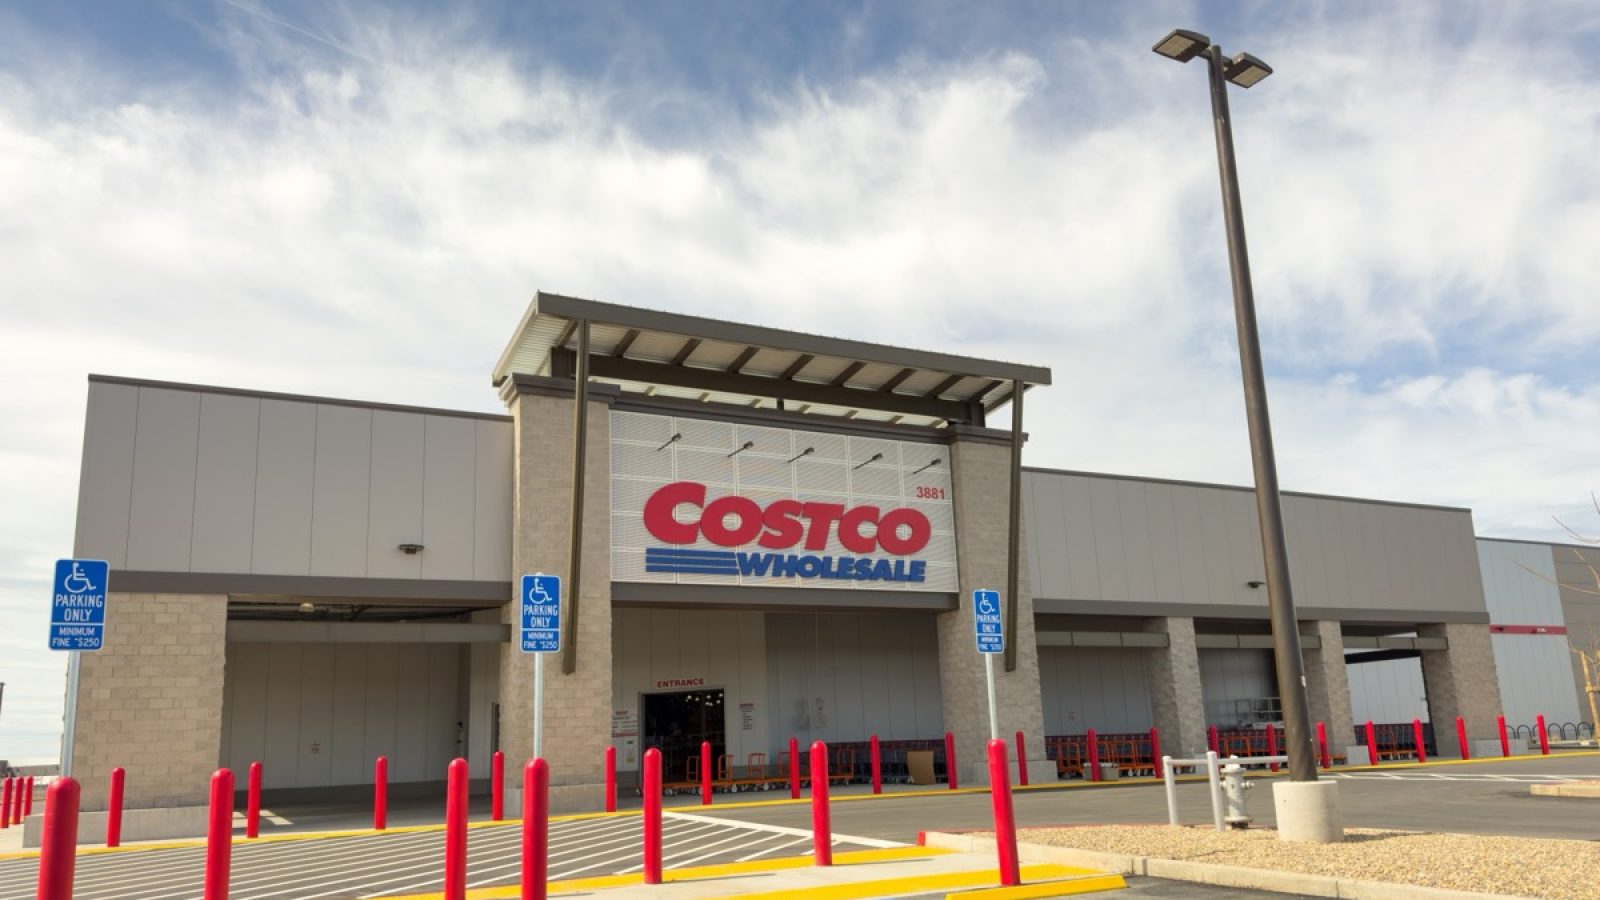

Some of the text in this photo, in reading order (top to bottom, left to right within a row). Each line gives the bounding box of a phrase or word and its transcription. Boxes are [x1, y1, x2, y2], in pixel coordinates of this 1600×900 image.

[916, 486, 945, 500] 3881
[643, 481, 932, 556] COSTCO
[736, 552, 927, 582] WHOLESALE
[55, 594, 104, 608] PARKING
[63, 608, 93, 622] ONLY
[523, 604, 558, 617] PARKING
[530, 616, 552, 628] ONLY
[982, 623, 996, 633] ONLY
[59, 627, 96, 637] MINIMUM
[527, 631, 554, 640] MINIMUM
[51, 636, 71, 647] FINE
[656, 678, 705, 688] ENTRANCE
